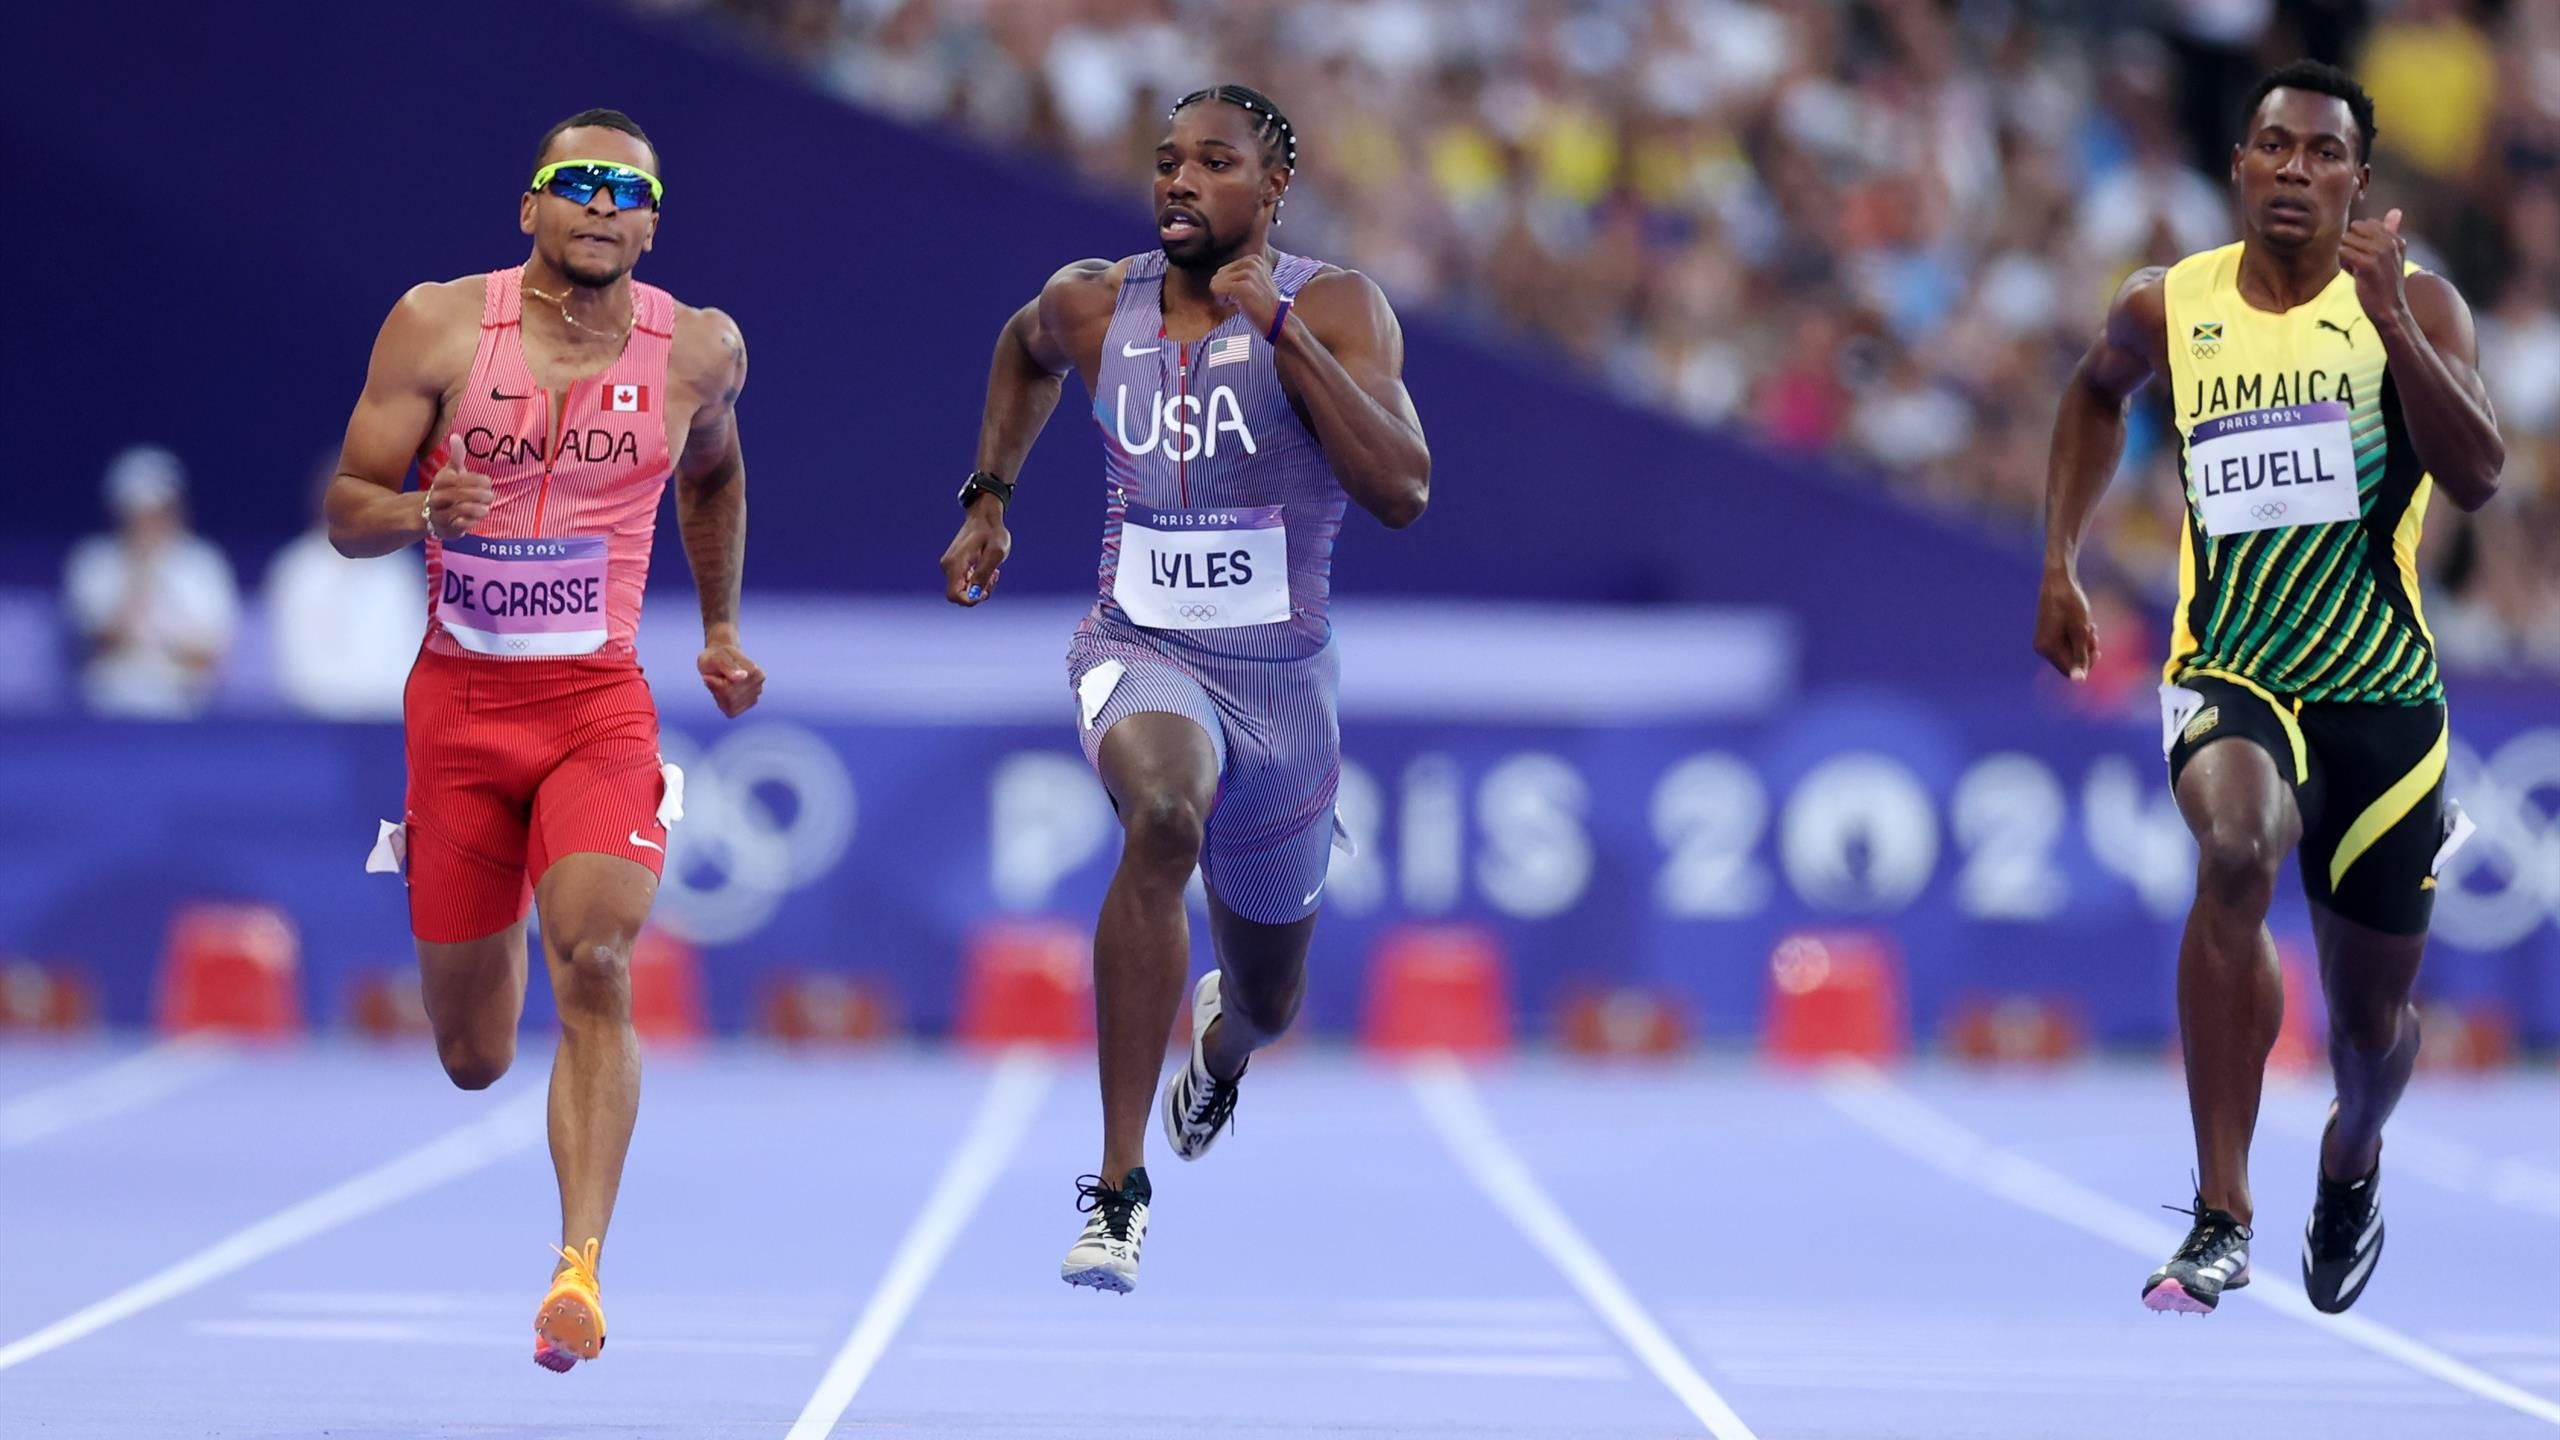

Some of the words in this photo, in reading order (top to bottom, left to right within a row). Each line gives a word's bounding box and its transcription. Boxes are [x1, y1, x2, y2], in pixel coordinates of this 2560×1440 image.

[2190, 369, 2356, 418] JAMAICA
[1116, 384, 1257, 462] USA
[2218, 414, 2258, 432] PARIS
[2262, 411, 2302, 426] 2024
[463, 427, 638, 466] CANADA
[2204, 448, 2335, 498] LEVELL
[1152, 514, 1193, 526] PARIS
[1198, 514, 1238, 526] 2024
[481, 542, 522, 556] PARIS
[527, 543, 566, 556] 2024
[1150, 549, 1253, 589] LYLES
[443, 569, 476, 610] DE
[481, 577, 600, 617] GRASSE
[990, 750, 1597, 919] PIS
[1648, 750, 2198, 920] 2024
